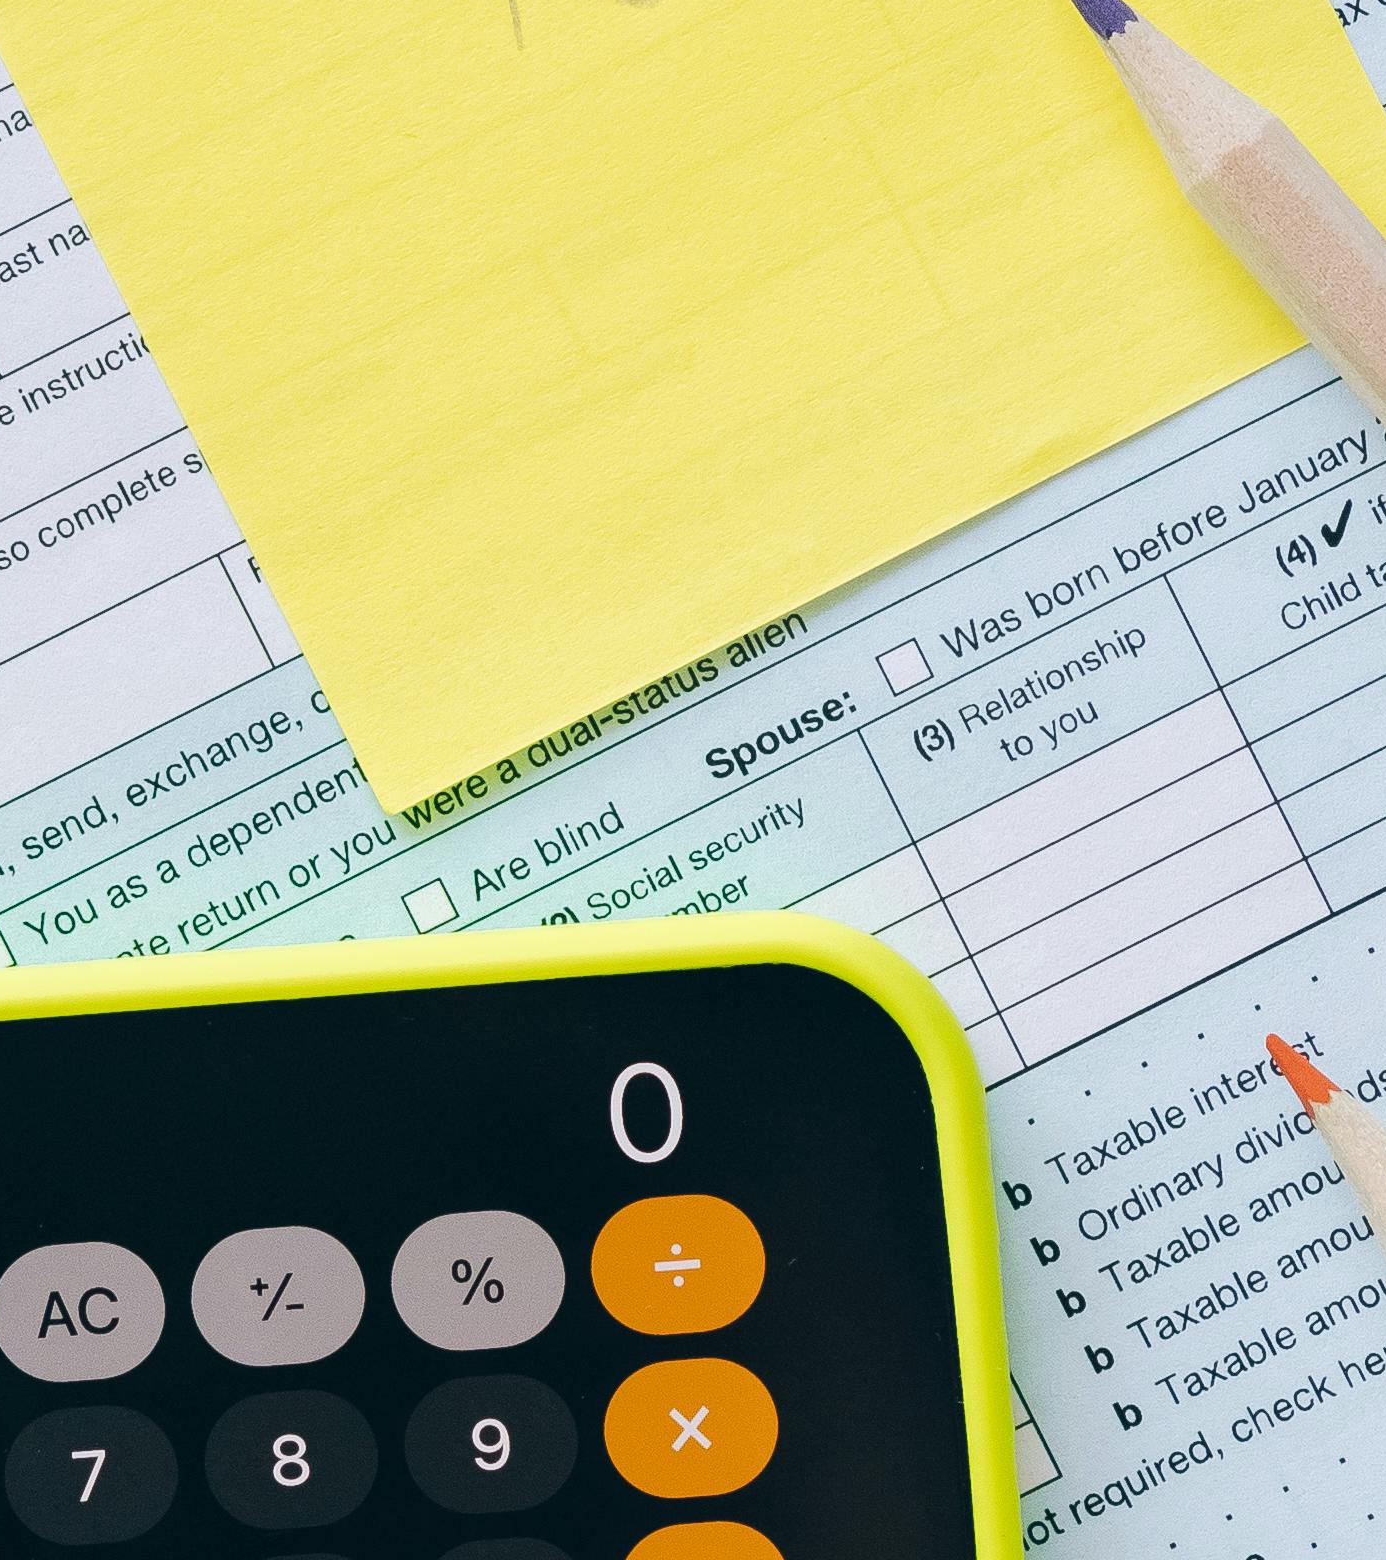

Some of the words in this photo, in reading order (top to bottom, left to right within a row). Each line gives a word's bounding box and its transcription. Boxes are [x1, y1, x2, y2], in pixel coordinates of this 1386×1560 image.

[937, 607, 1024, 659] Was
[1023, 563, 1112, 620] born
[1111, 503, 1229, 576] before
[1237, 427, 1369, 515] January
[912, 717, 957, 764] (3)
[956, 627, 1148, 735] Relationship
[998, 734, 1035, 763] to
[1038, 699, 1100, 752] you
[472, 855, 532, 904] Are
[532, 799, 626, 869] blind
[608, 1060, 685, 1165] 0
[36, 1285, 121, 1340] AC
[69, 1447, 108, 1505] 7
[270, 1432, 312, 1489] 8
[470, 1416, 512, 1473] 9
